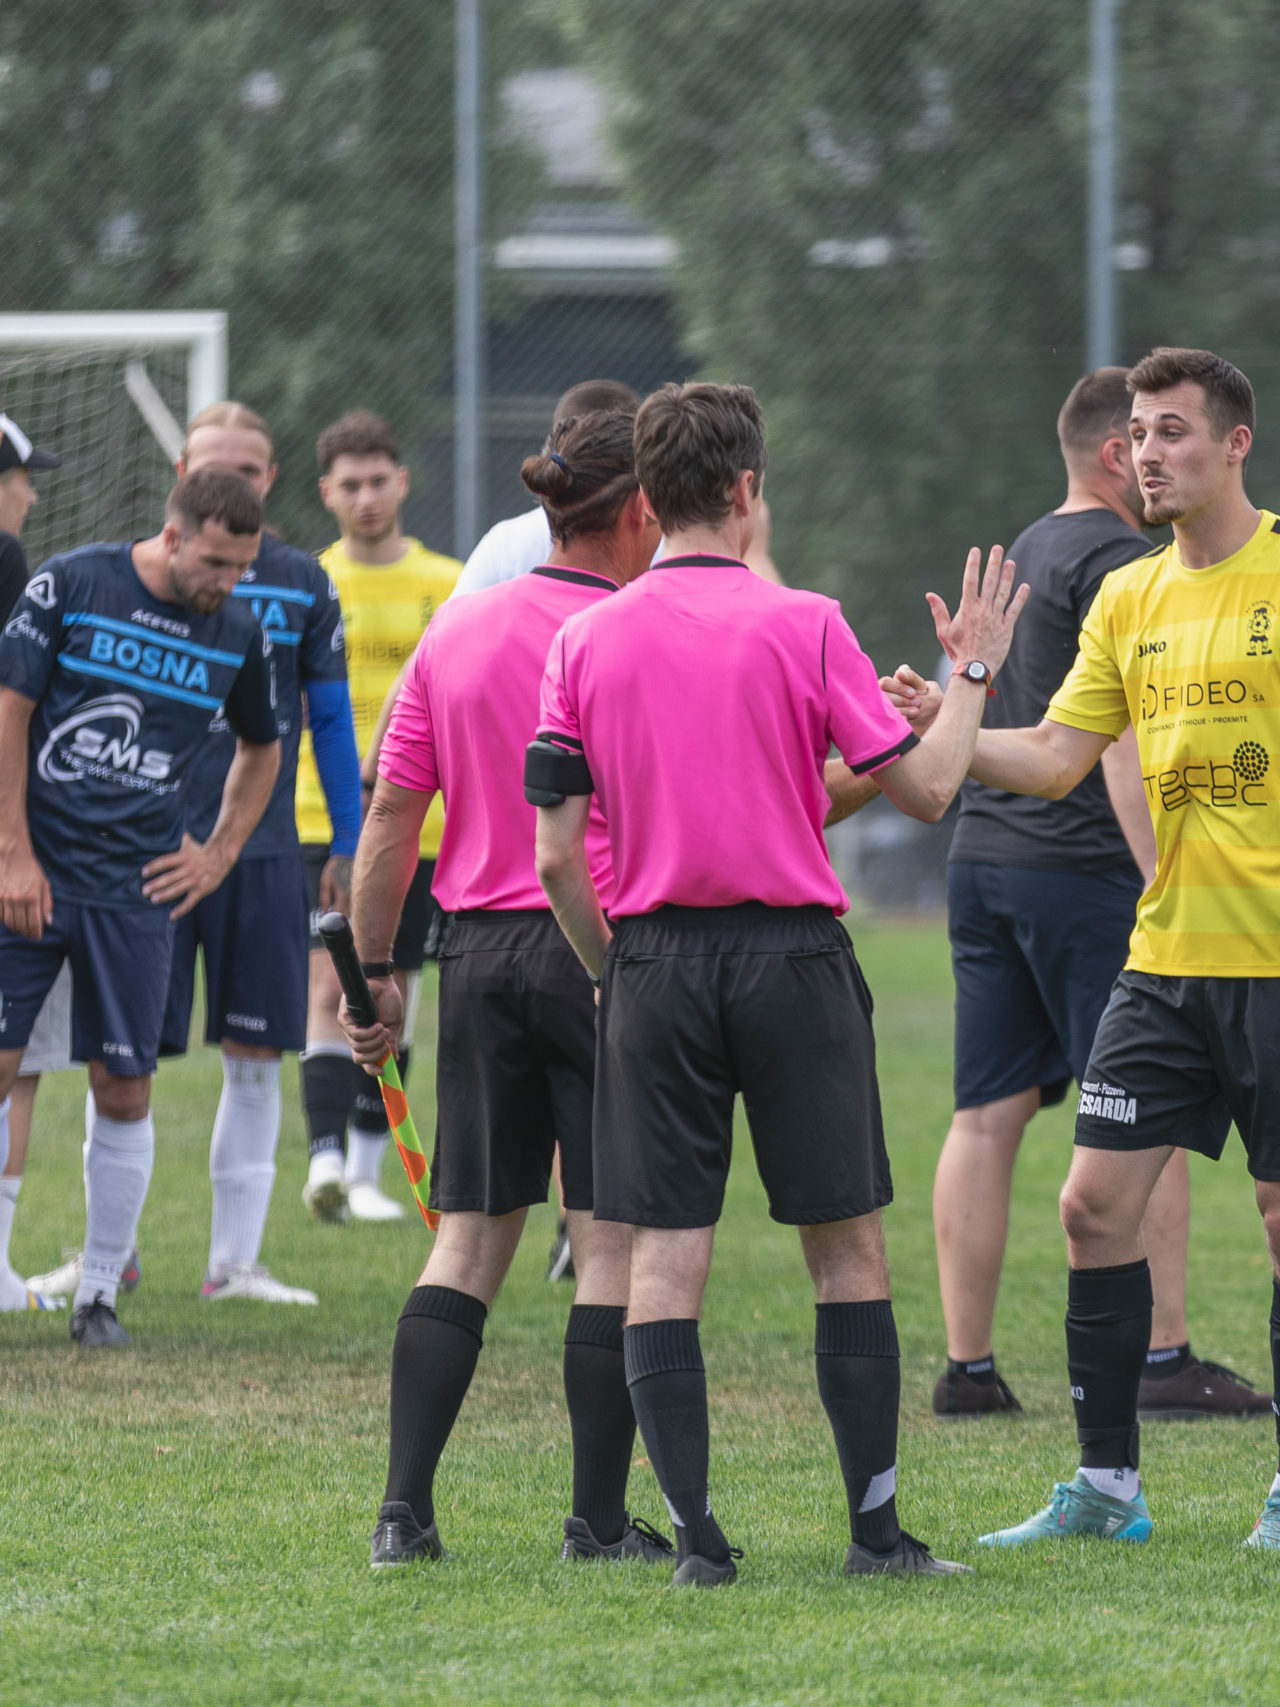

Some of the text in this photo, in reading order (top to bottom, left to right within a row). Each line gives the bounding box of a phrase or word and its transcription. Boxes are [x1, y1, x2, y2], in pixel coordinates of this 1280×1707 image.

[90, 630, 209, 693] BOSNA
[1138, 641, 1167, 658] JAKO
[1163, 680, 1247, 712] FIDEO
[1253, 694, 1265, 702] SA
[69, 727, 174, 780] SMS
